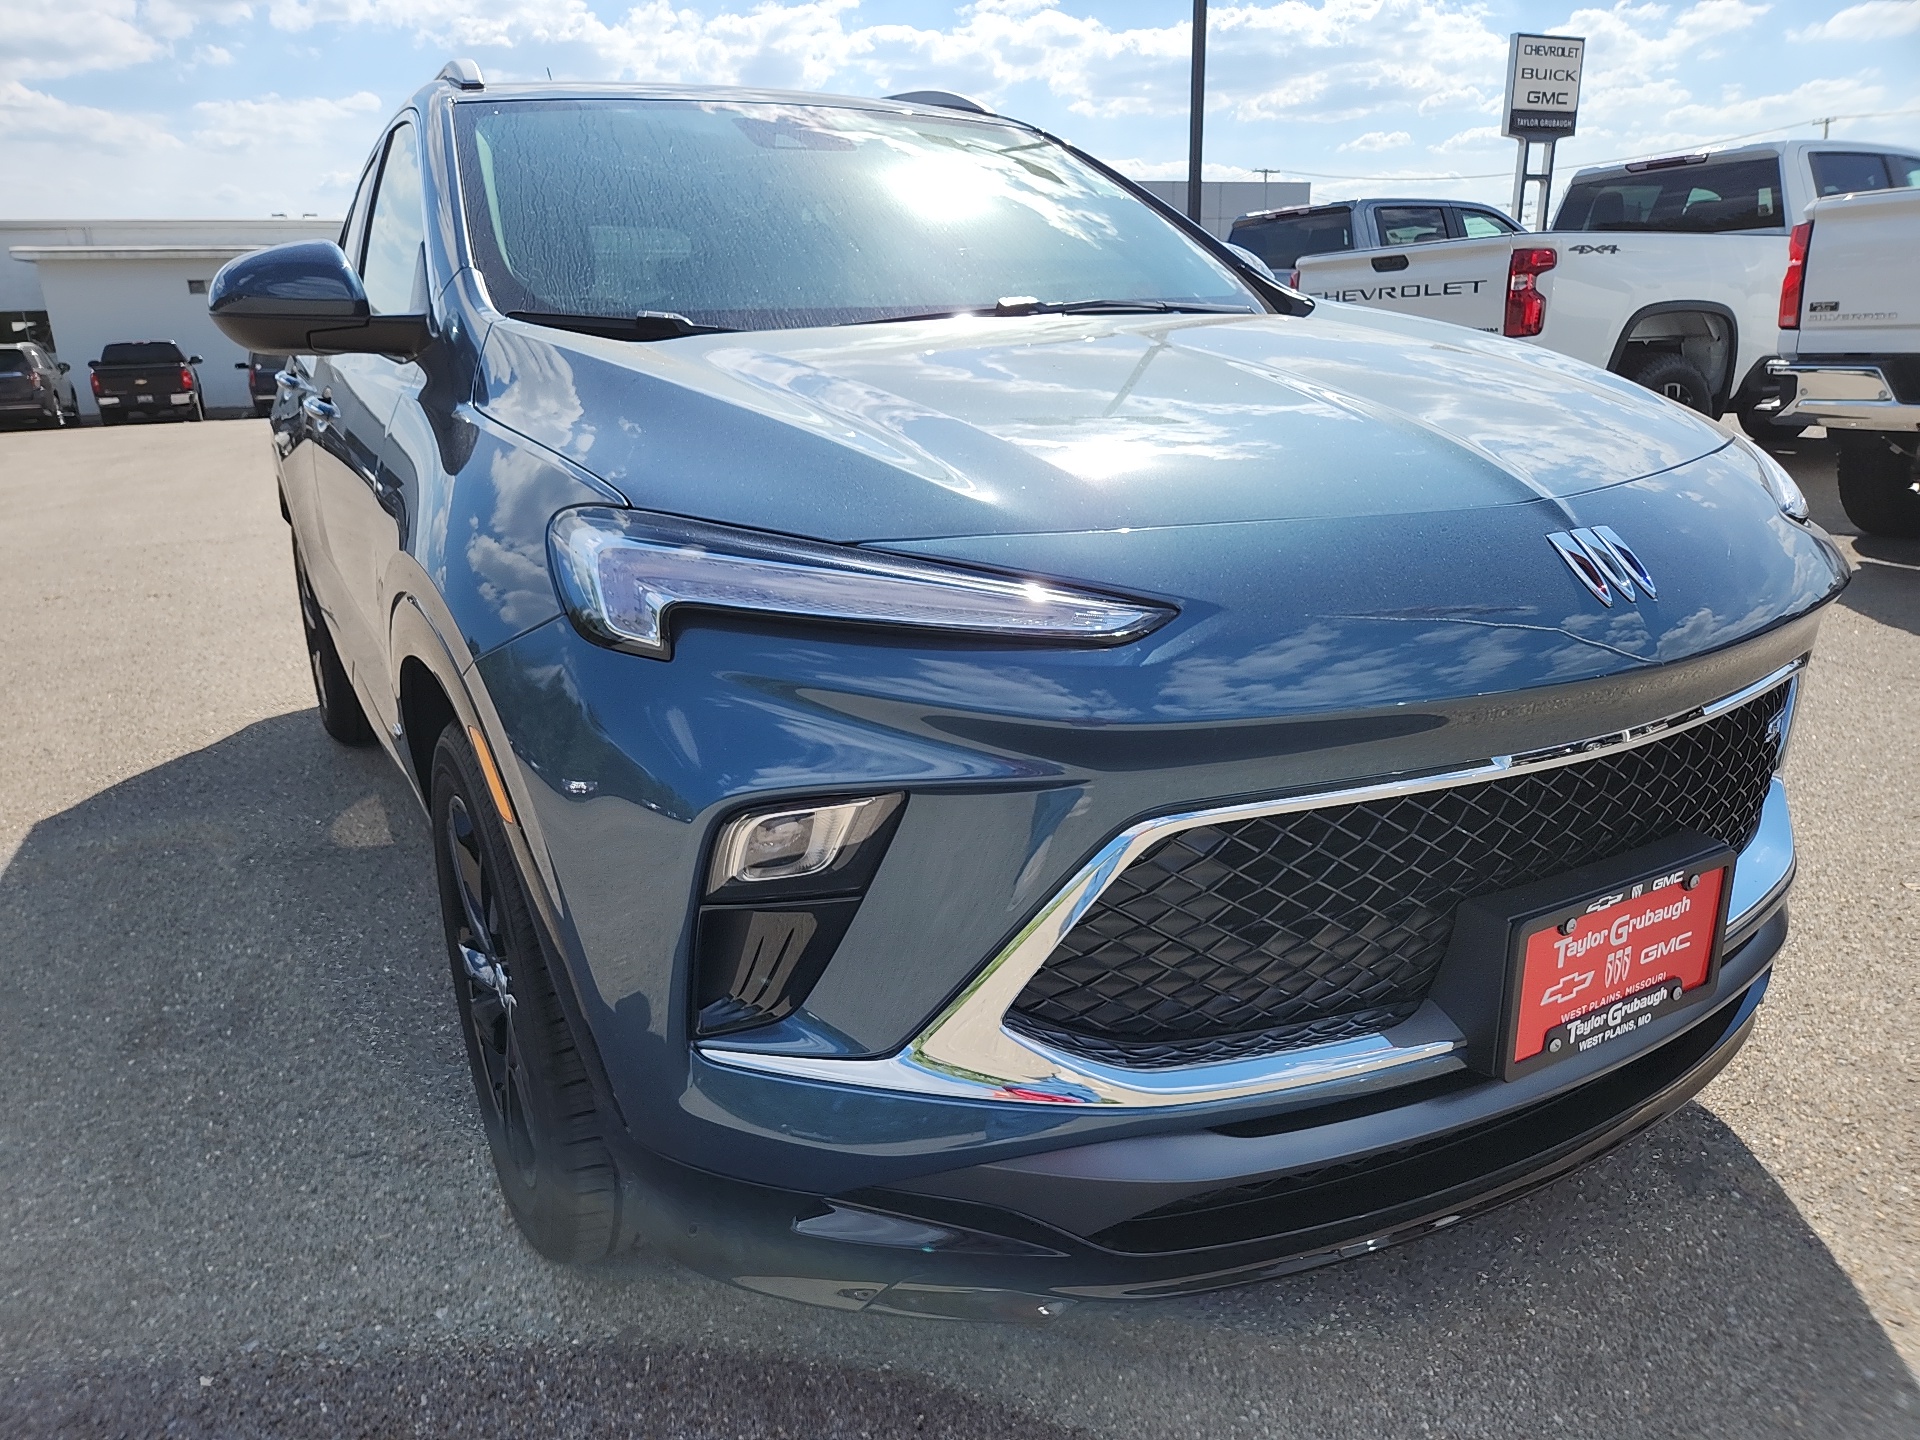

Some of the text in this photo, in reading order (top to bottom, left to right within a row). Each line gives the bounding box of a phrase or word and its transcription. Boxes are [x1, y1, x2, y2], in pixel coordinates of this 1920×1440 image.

[1524, 45, 1580, 59] CHEVROLET
[1521, 68, 1577, 82] BUICK
[1527, 91, 1568, 105] GMC
[1517, 117, 1572, 128] TAYLOR GRUBAUGH
[1652, 871, 1685, 891] GMC
[1554, 896, 1691, 968] Taylor Grubaugh
[1640, 931, 1692, 965] GMC
[1561, 1005, 1589, 1023] WEST
[1625, 971, 1667, 996] MISSOURI
[1567, 986, 1668, 1044] Taylor Grubaugh
[1578, 1013, 1652, 1052] WEST PLAINS, MO
